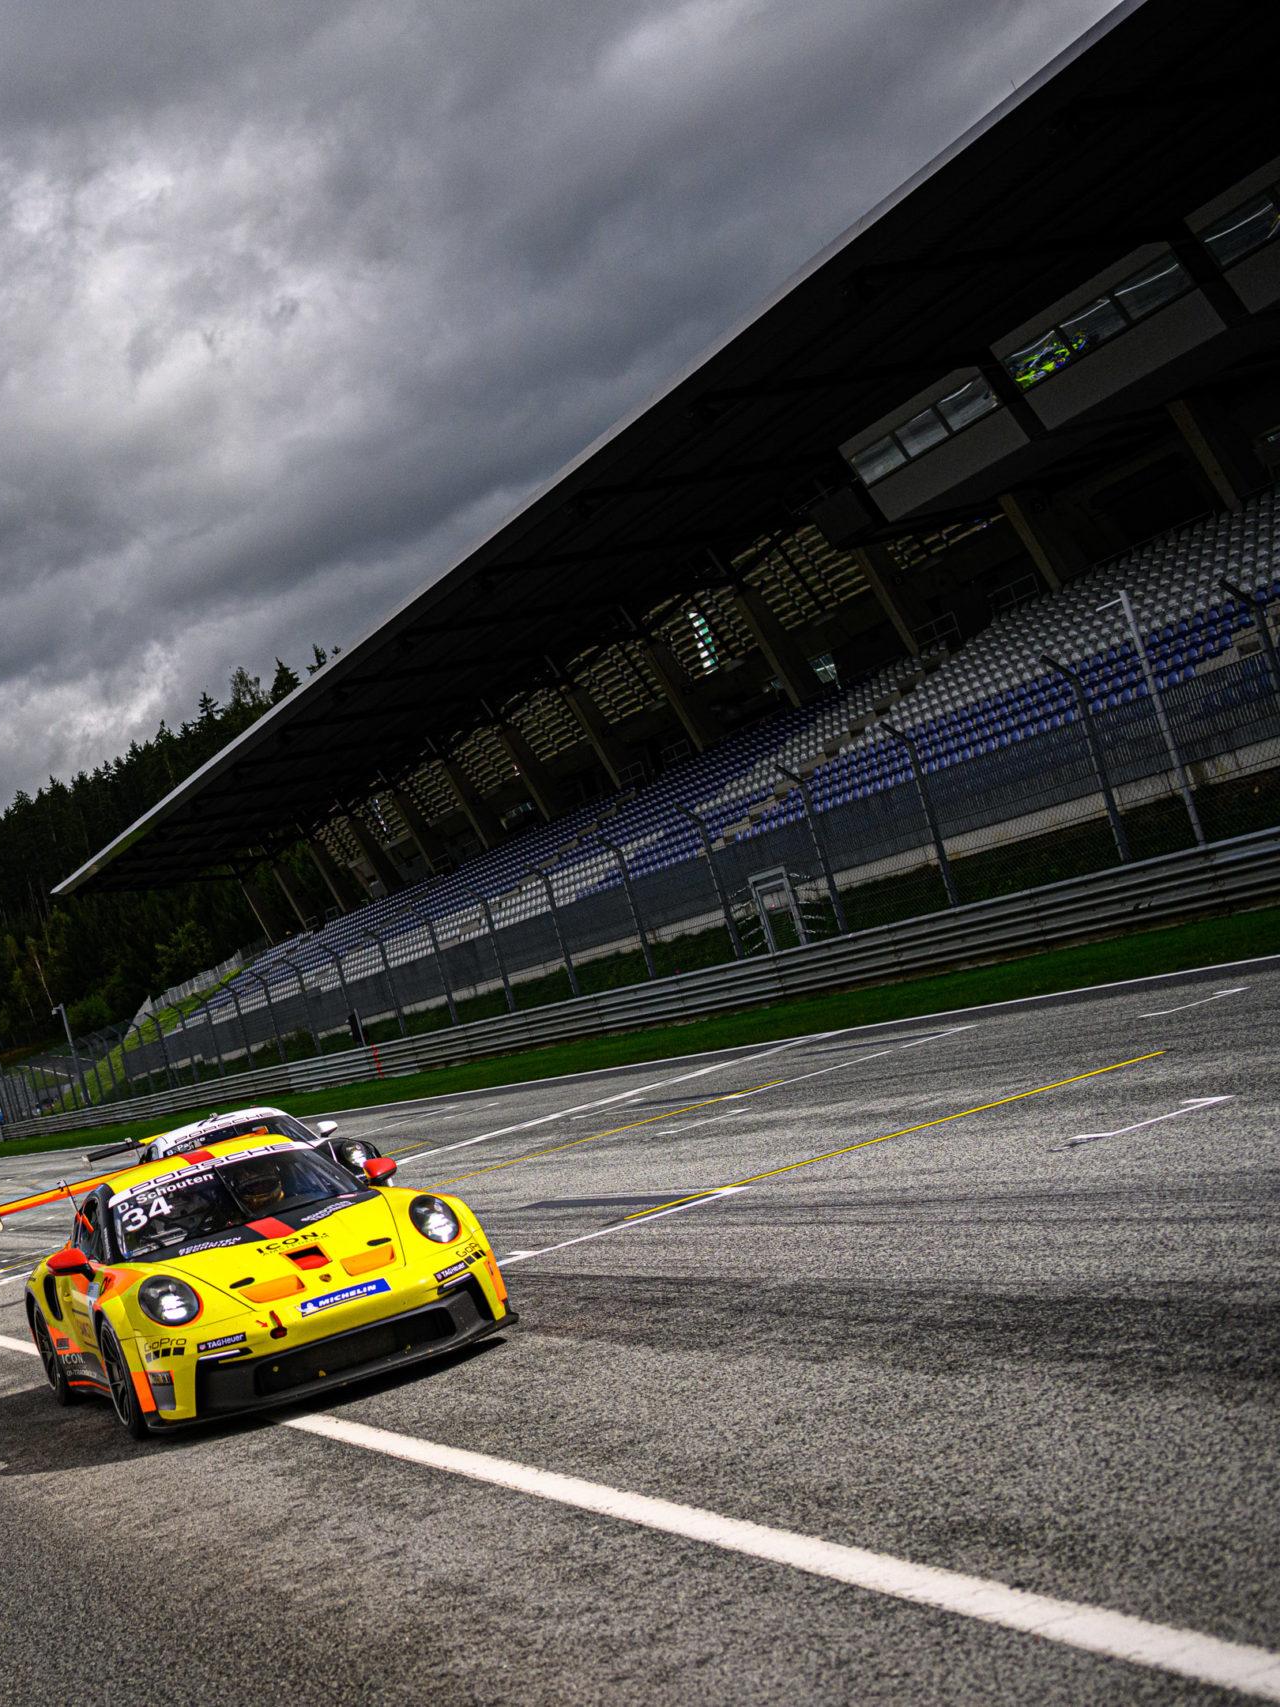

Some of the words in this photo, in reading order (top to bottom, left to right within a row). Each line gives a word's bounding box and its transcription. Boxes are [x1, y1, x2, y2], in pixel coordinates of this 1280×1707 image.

[174, 1111, 275, 1144] PORSCHE
[129, 1142, 294, 1196] PORSCHE
[118, 1202, 134, 1214] D.
[135, 1172, 215, 1205] Schouten
[121, 1196, 174, 1233] 34
[318, 1284, 377, 1307] MICHELIN
[144, 1338, 187, 1352] GoPro
